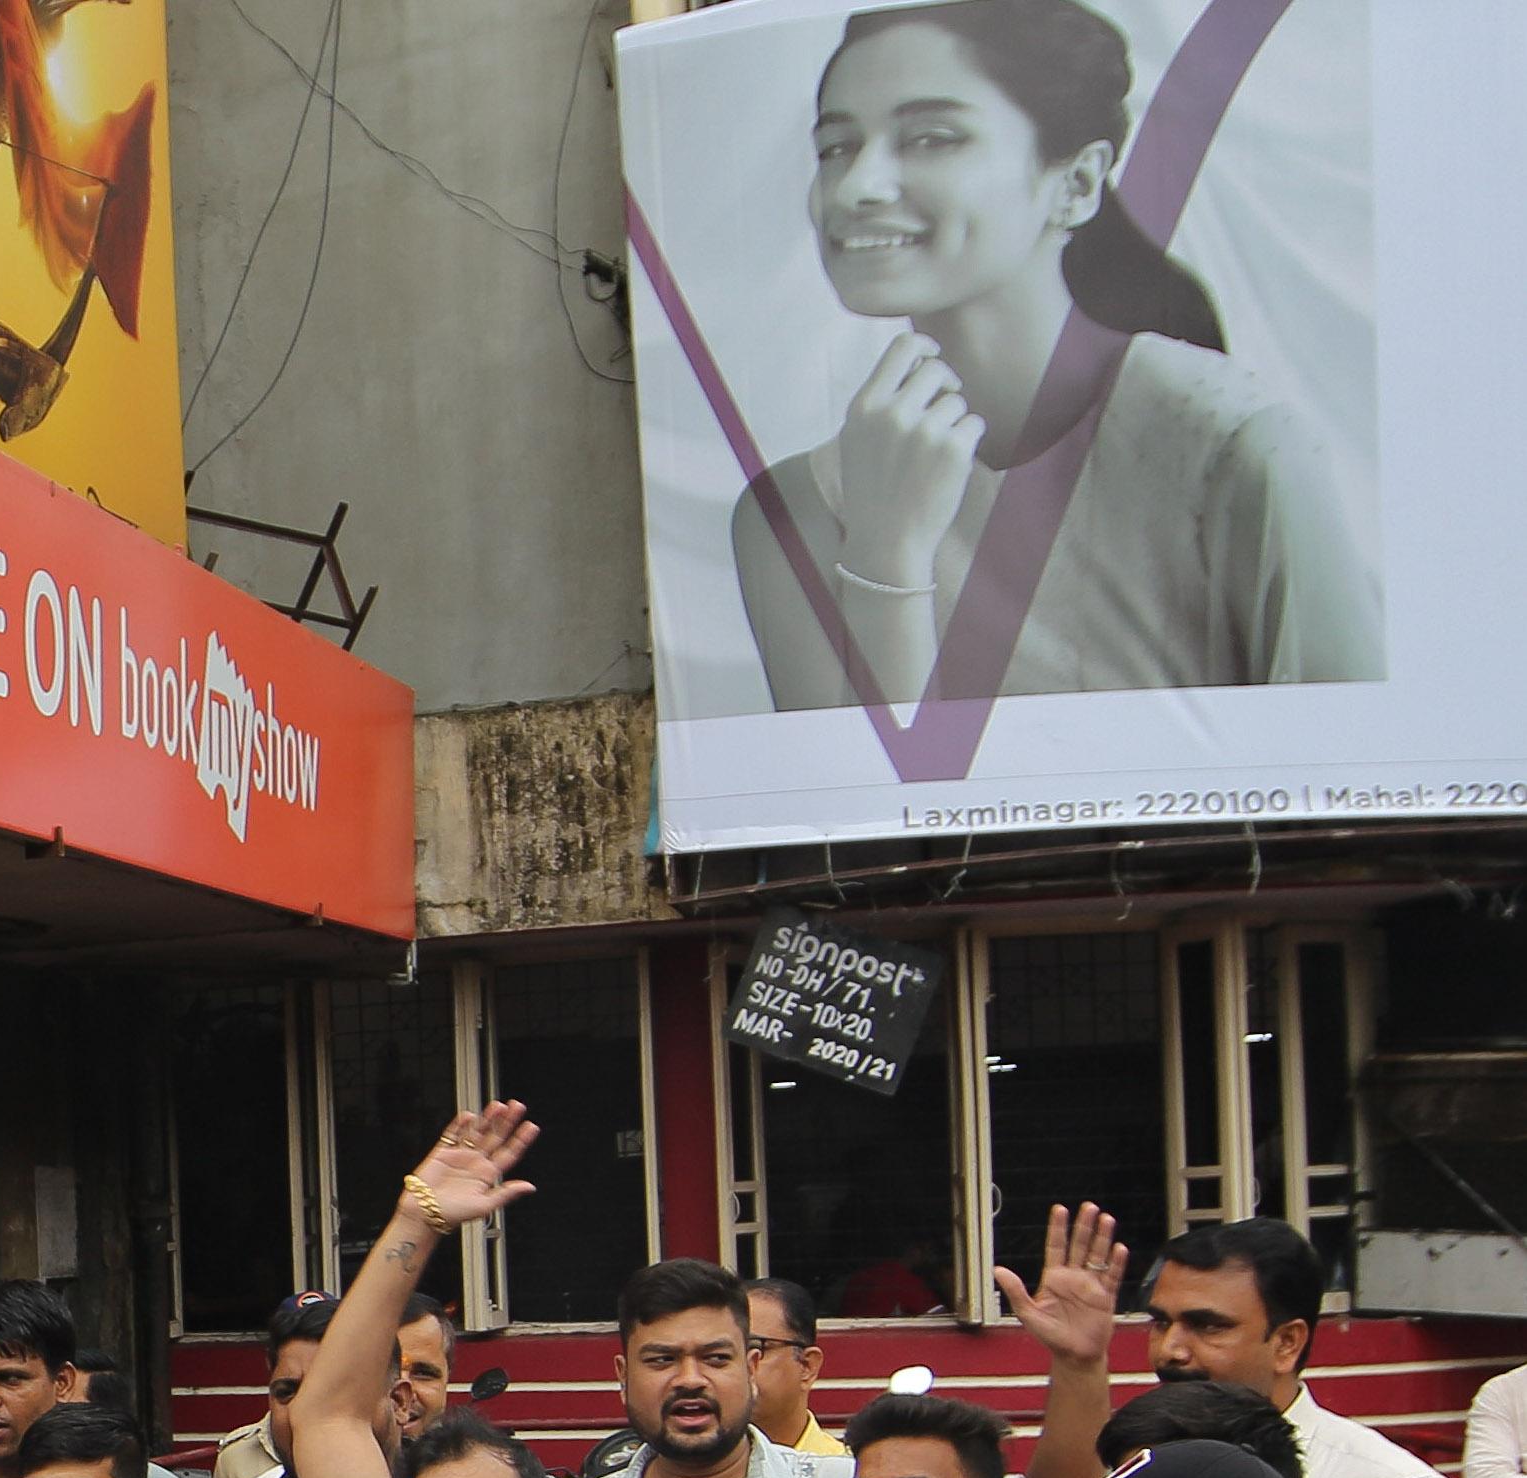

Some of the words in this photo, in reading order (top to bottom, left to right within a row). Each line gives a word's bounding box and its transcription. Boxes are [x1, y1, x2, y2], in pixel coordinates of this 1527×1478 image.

[25, 568, 103, 736] ON
[902, 797, 1125, 831] Laxminagar:
[1137, 787, 1290, 817] 2220100
[1323, 784, 1435, 810] Mahal:
[773, 922, 914, 997] signpost
[733, 1008, 794, 1043] MAR-
[808, 1037, 897, 1081] 2020/21
